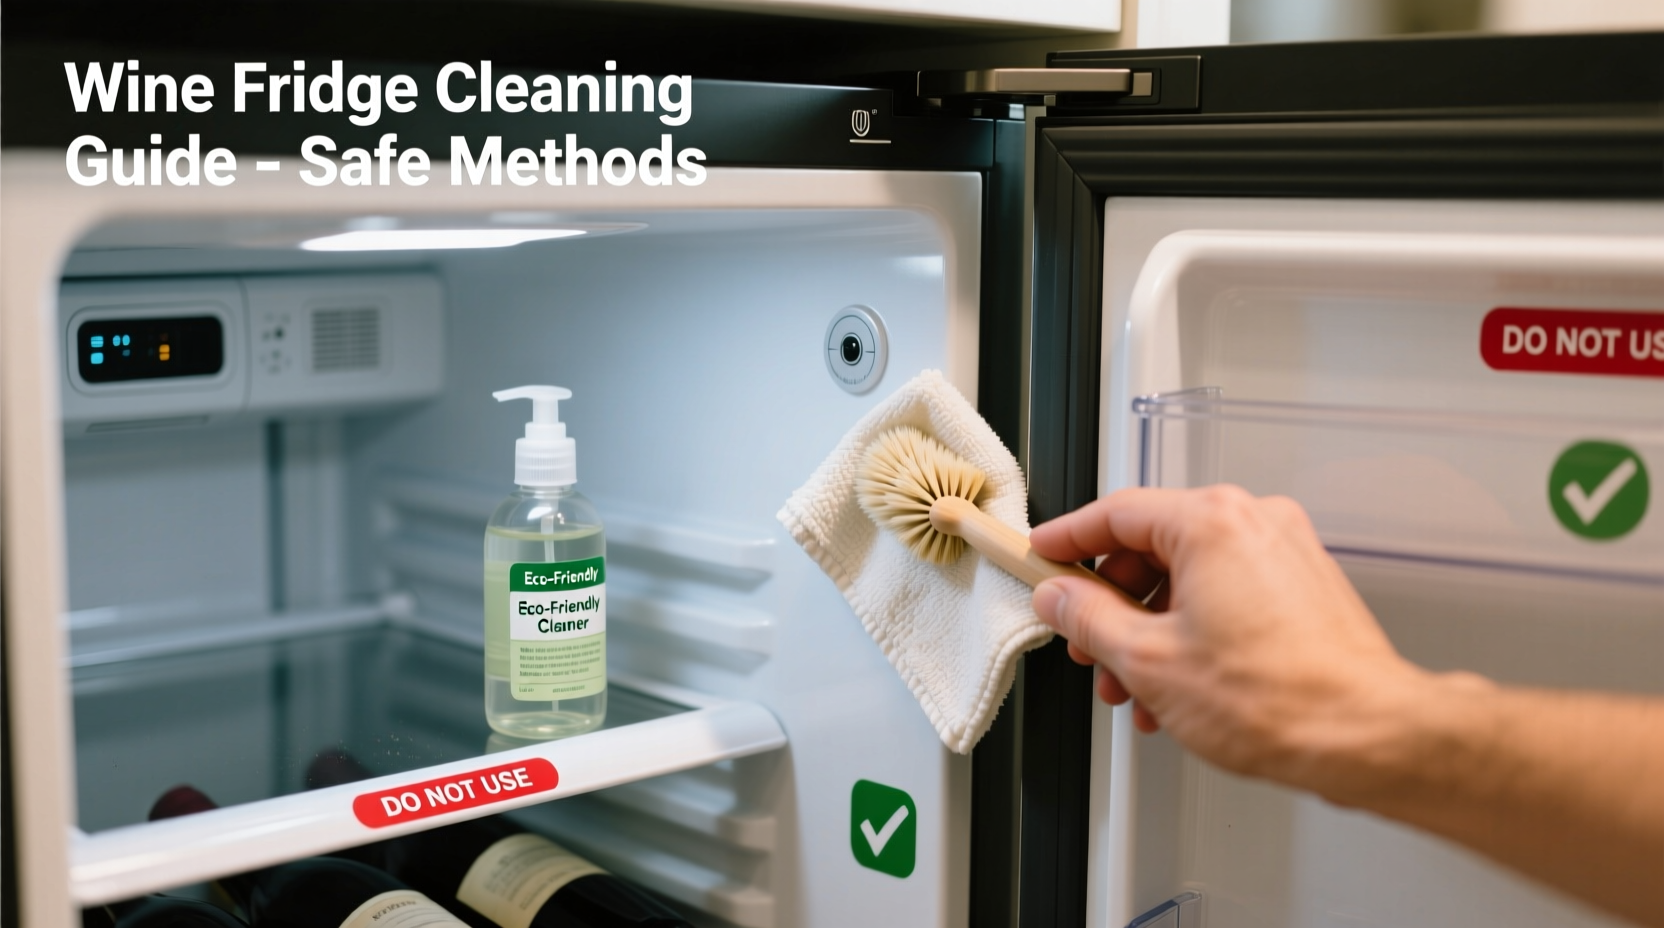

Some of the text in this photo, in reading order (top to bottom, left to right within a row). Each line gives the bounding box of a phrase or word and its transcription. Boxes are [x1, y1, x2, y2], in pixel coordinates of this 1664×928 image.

[1502, 325, 1548, 355] DO
[1556, 327, 1622, 358] NOT
[524, 566, 599, 585] Eco-Friendly
[518, 594, 600, 615] Eco-Friendly
[380, 767, 533, 817] DO NOT USE
